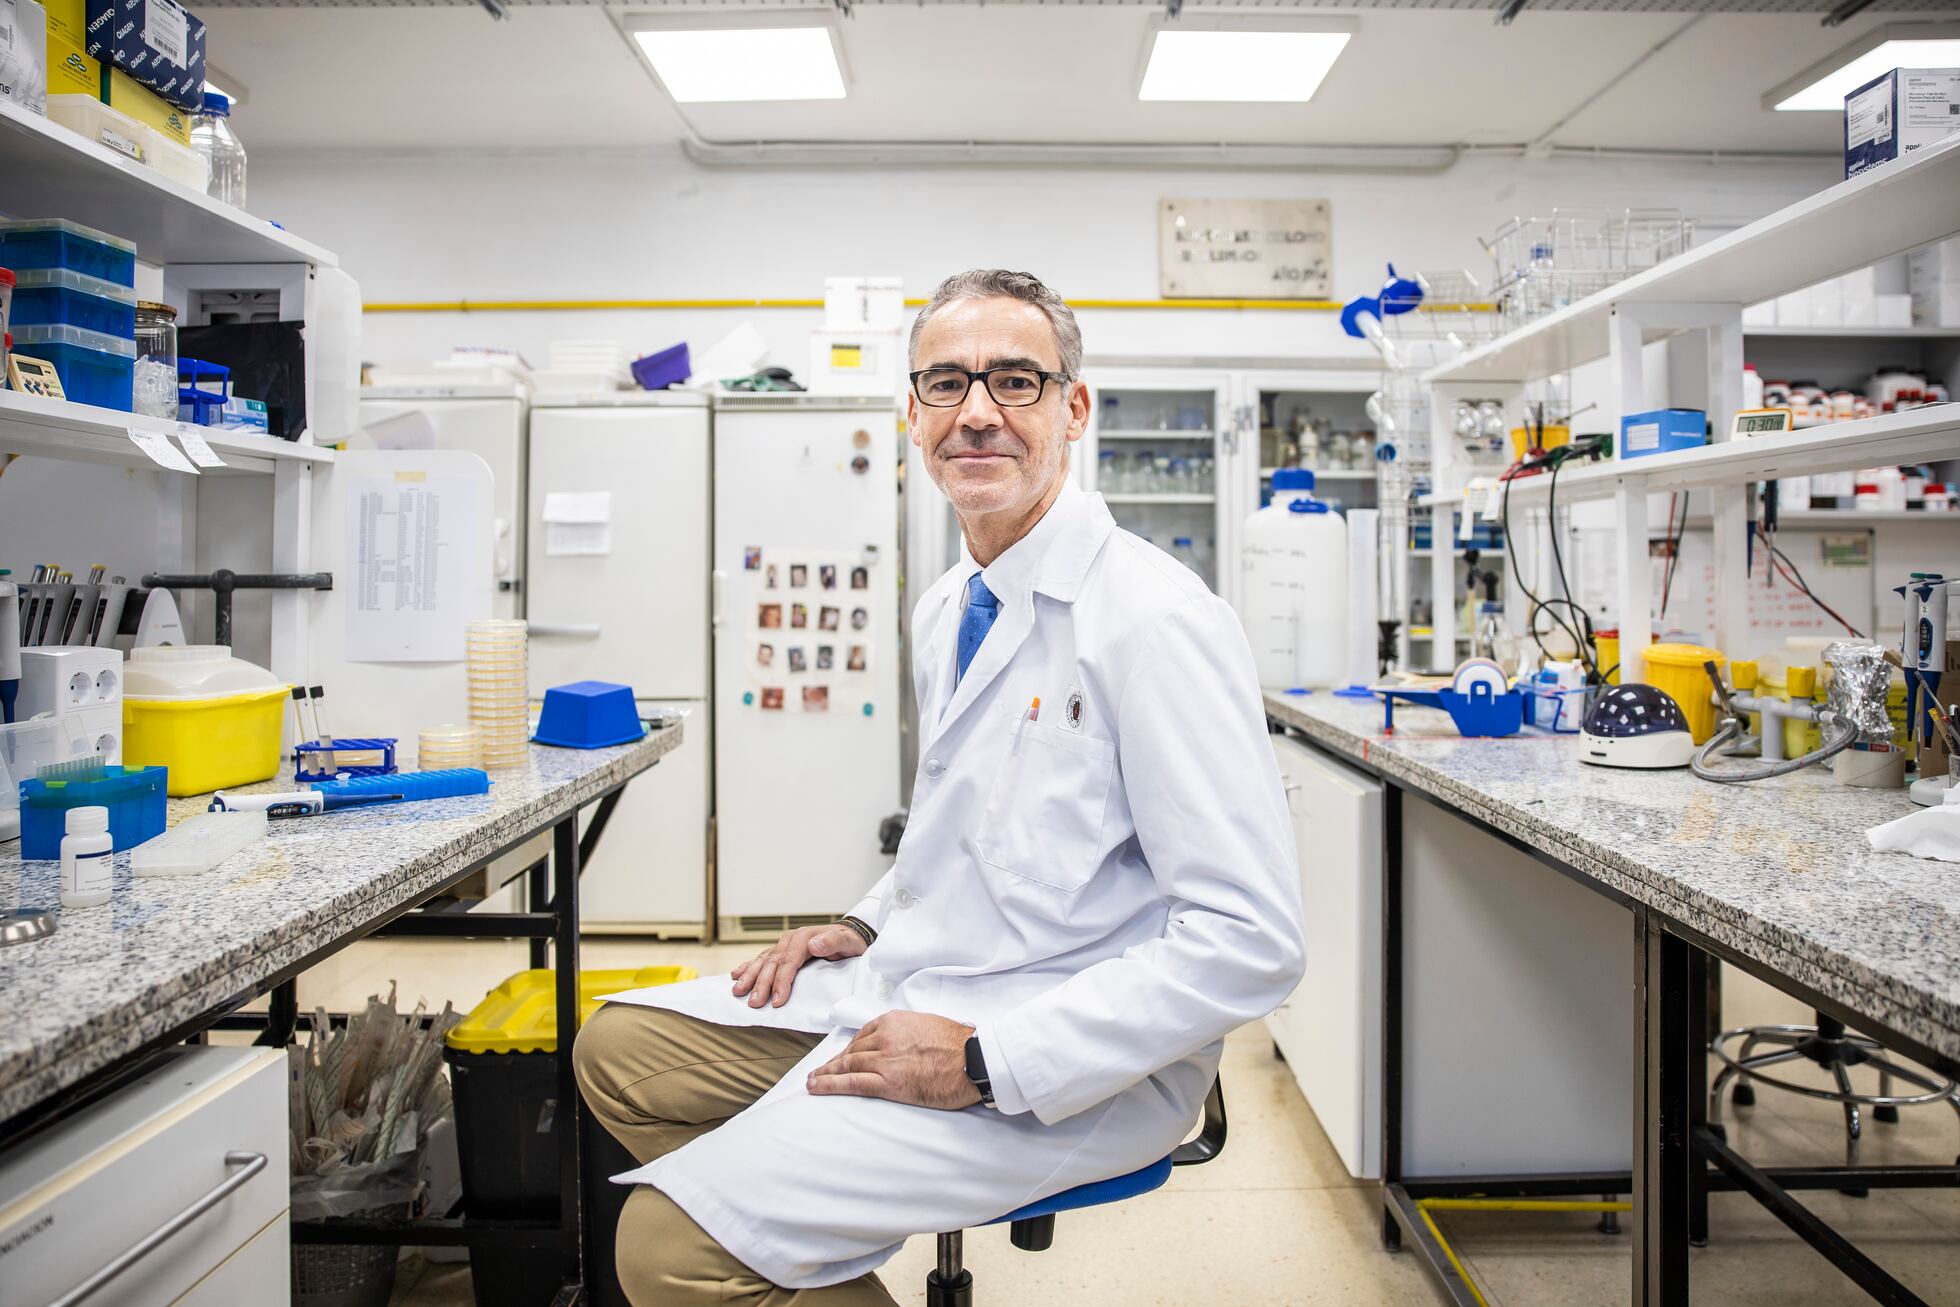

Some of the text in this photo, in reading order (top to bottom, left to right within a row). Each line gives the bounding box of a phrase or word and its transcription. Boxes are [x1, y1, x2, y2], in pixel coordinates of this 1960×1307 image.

[88, 8, 115, 33] QIAGEN
[116, 20, 135, 40] QIAGEN
[130, 49, 148, 69] QIAGEN
[180, 77, 194, 95] QIAGEN
